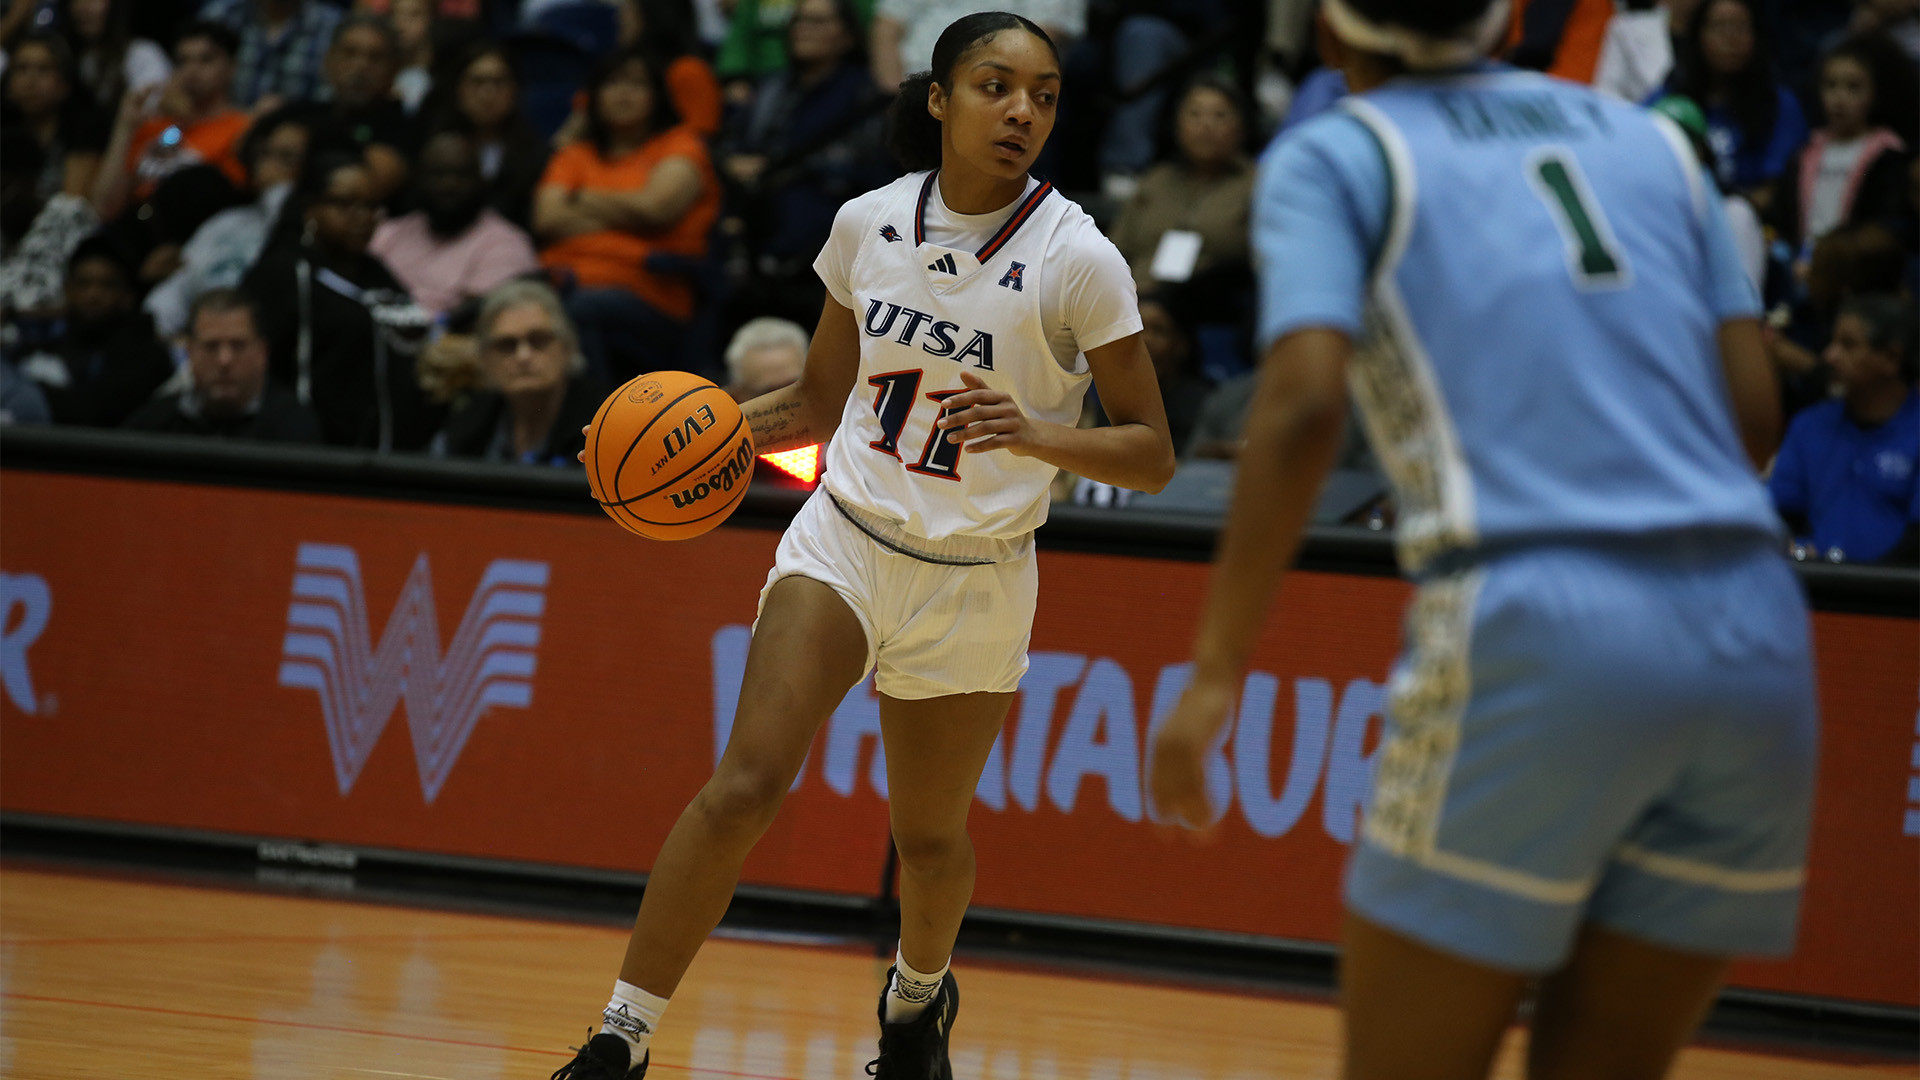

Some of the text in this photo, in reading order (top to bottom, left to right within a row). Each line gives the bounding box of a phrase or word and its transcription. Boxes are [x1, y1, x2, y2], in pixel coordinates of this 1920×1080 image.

[1530, 152, 1626, 284] 1
[998, 260, 1026, 292] A
[864, 298, 995, 371] UTSA
[650, 403, 717, 477] EVO NXT
[868, 368, 976, 482] 11
[668, 437, 754, 509] Wilson
